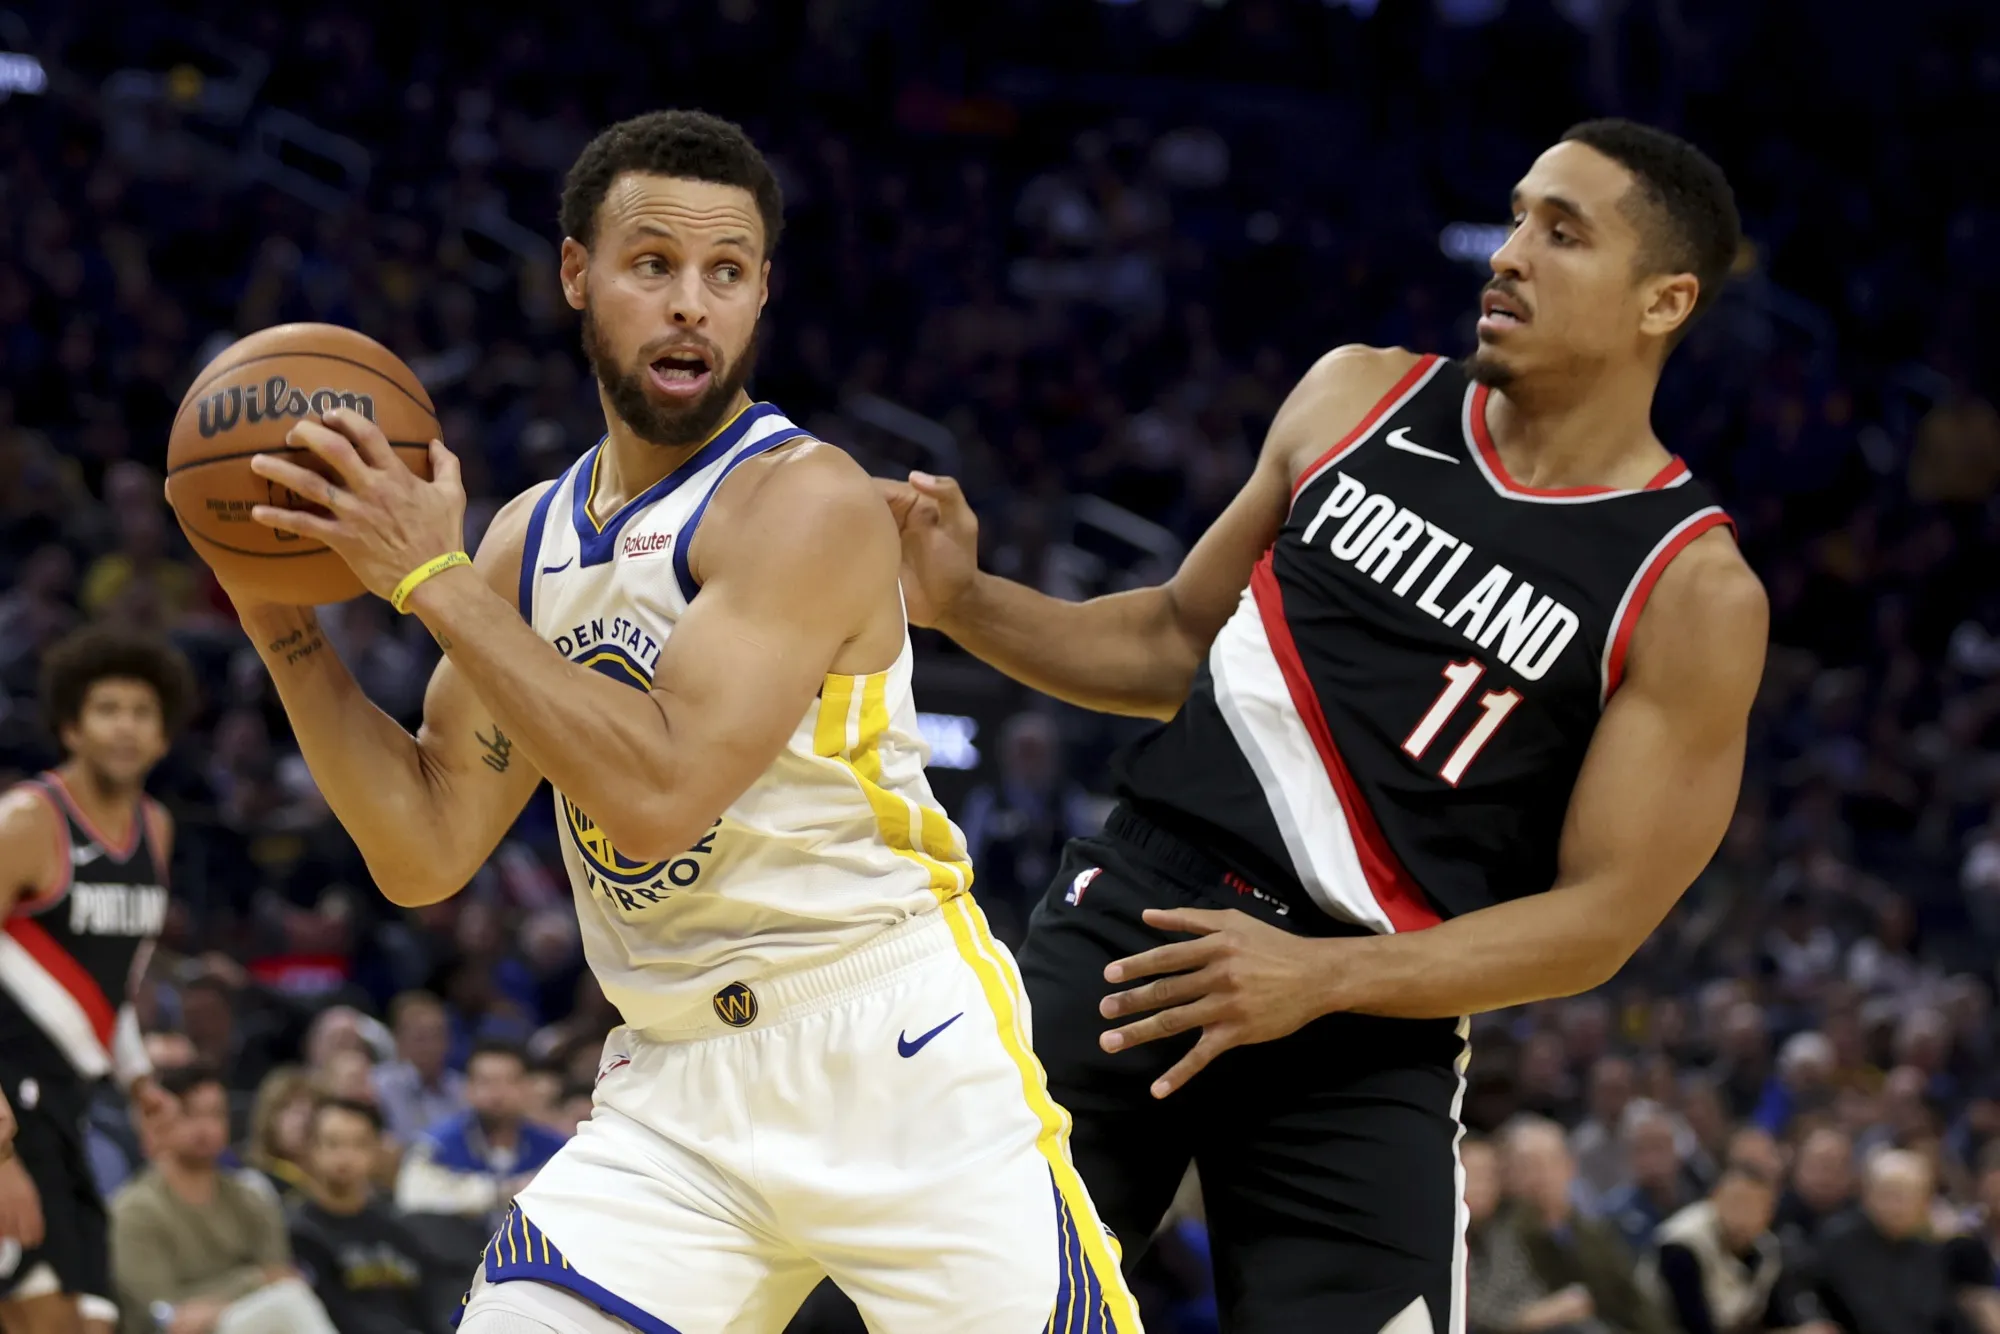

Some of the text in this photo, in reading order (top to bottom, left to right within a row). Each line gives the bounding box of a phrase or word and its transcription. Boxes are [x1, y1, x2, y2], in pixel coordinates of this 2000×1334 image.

[198, 376, 377, 439] Wilson
[621, 532, 672, 555] Rakuten
[1301, 471, 1580, 682] PORTLAND
[553, 618, 604, 658] DEN
[1400, 656, 1525, 788] 11
